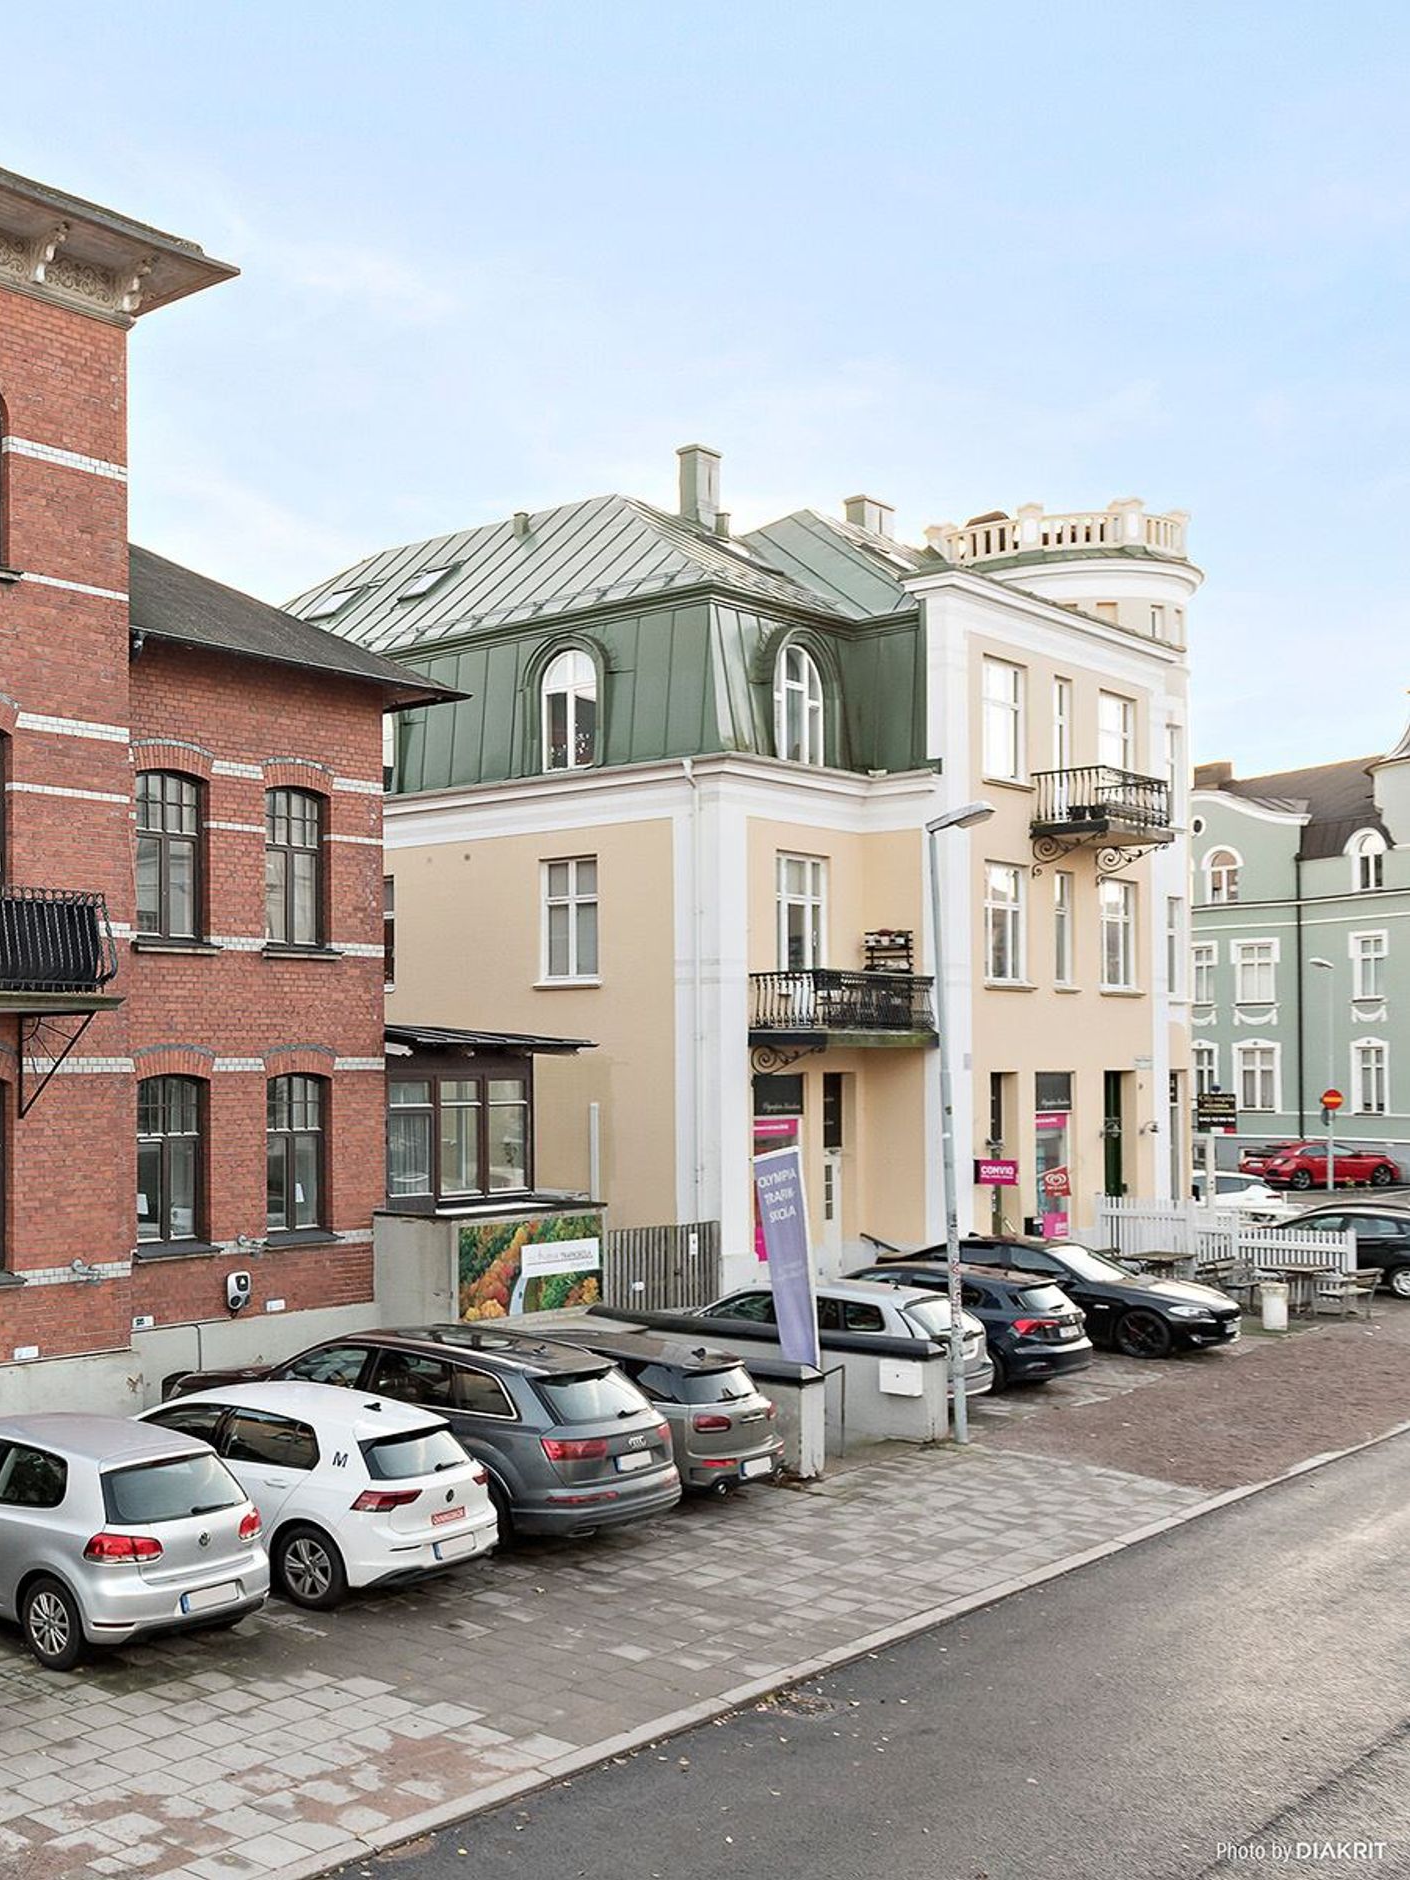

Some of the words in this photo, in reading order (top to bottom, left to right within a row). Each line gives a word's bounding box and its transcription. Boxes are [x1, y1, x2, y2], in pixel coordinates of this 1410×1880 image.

[757, 1167, 797, 1189] OLYMPIA
[770, 1204, 797, 1223] SKOLA
[332, 1451, 349, 1467] M
